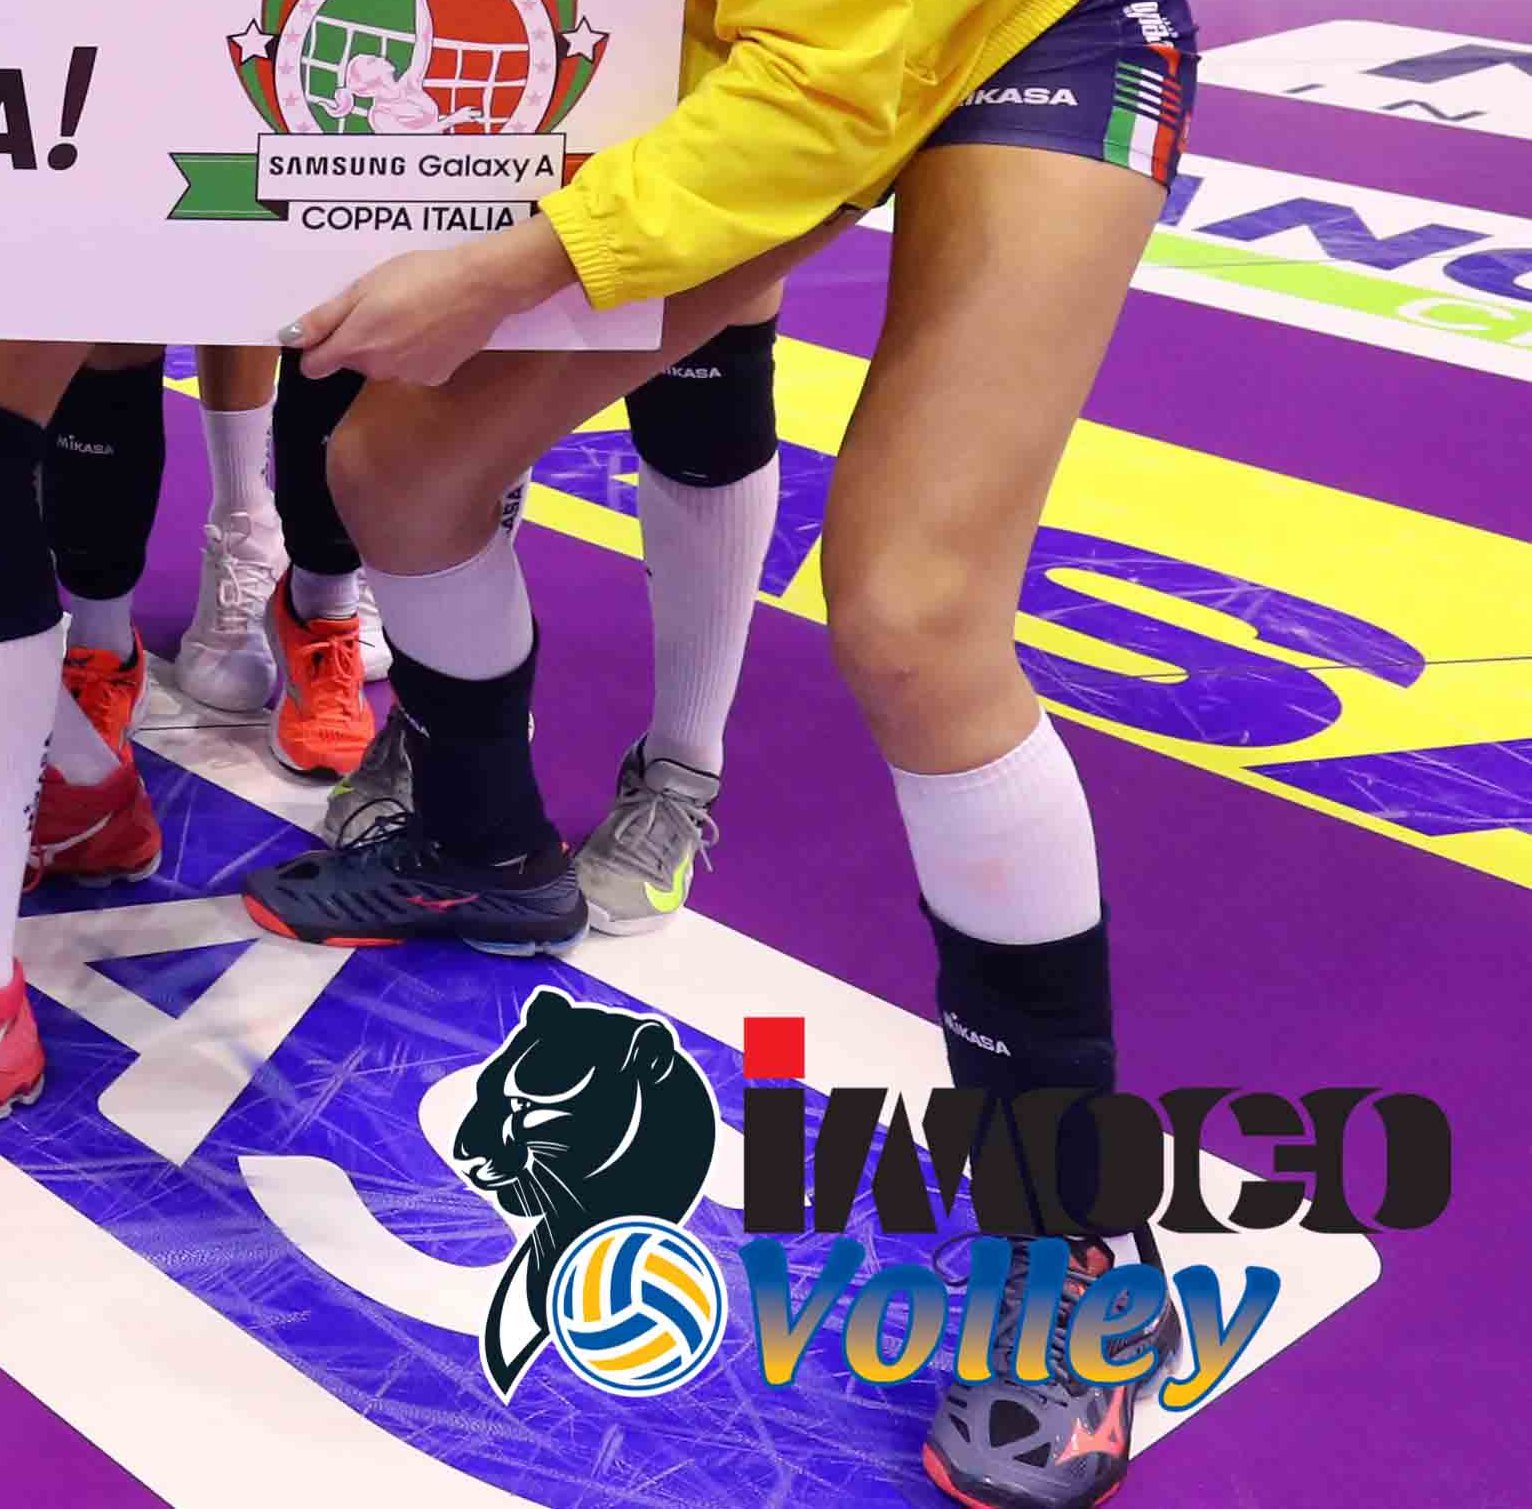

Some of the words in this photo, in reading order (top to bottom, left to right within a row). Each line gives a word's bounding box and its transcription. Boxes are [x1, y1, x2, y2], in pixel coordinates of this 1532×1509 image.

[269, 156, 405, 176] SAMSUNG
[418, 154, 530, 183] Galaxy
[534, 154, 554, 177] A
[302, 206, 412, 231] COPPA
[423, 204, 514, 231] ITALIA
